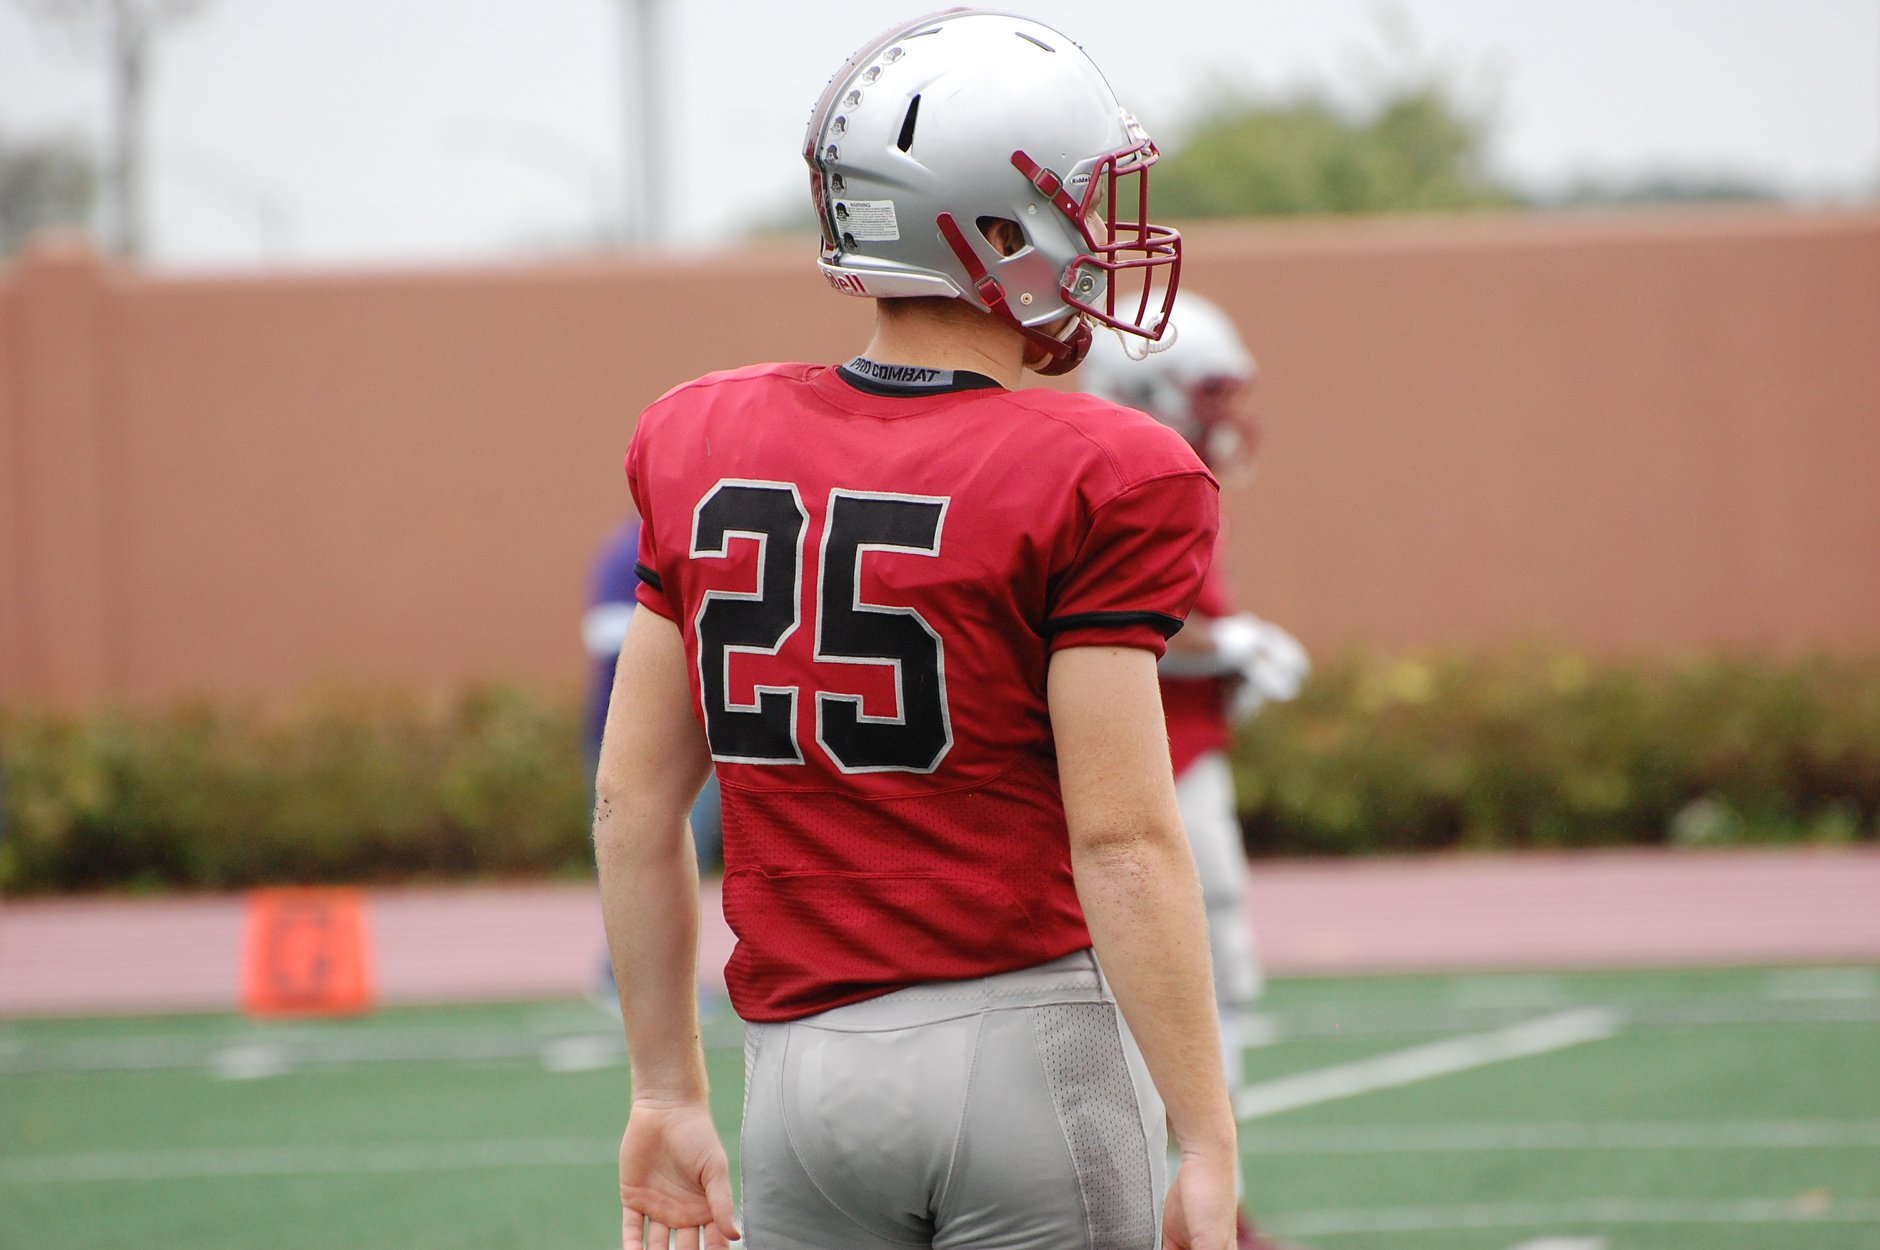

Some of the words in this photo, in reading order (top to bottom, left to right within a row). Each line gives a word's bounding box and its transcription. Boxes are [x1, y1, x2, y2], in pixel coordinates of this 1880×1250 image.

[850, 357, 872, 375] PRO
[872, 364, 941, 383] COMBAT
[689, 478, 954, 774] 25
